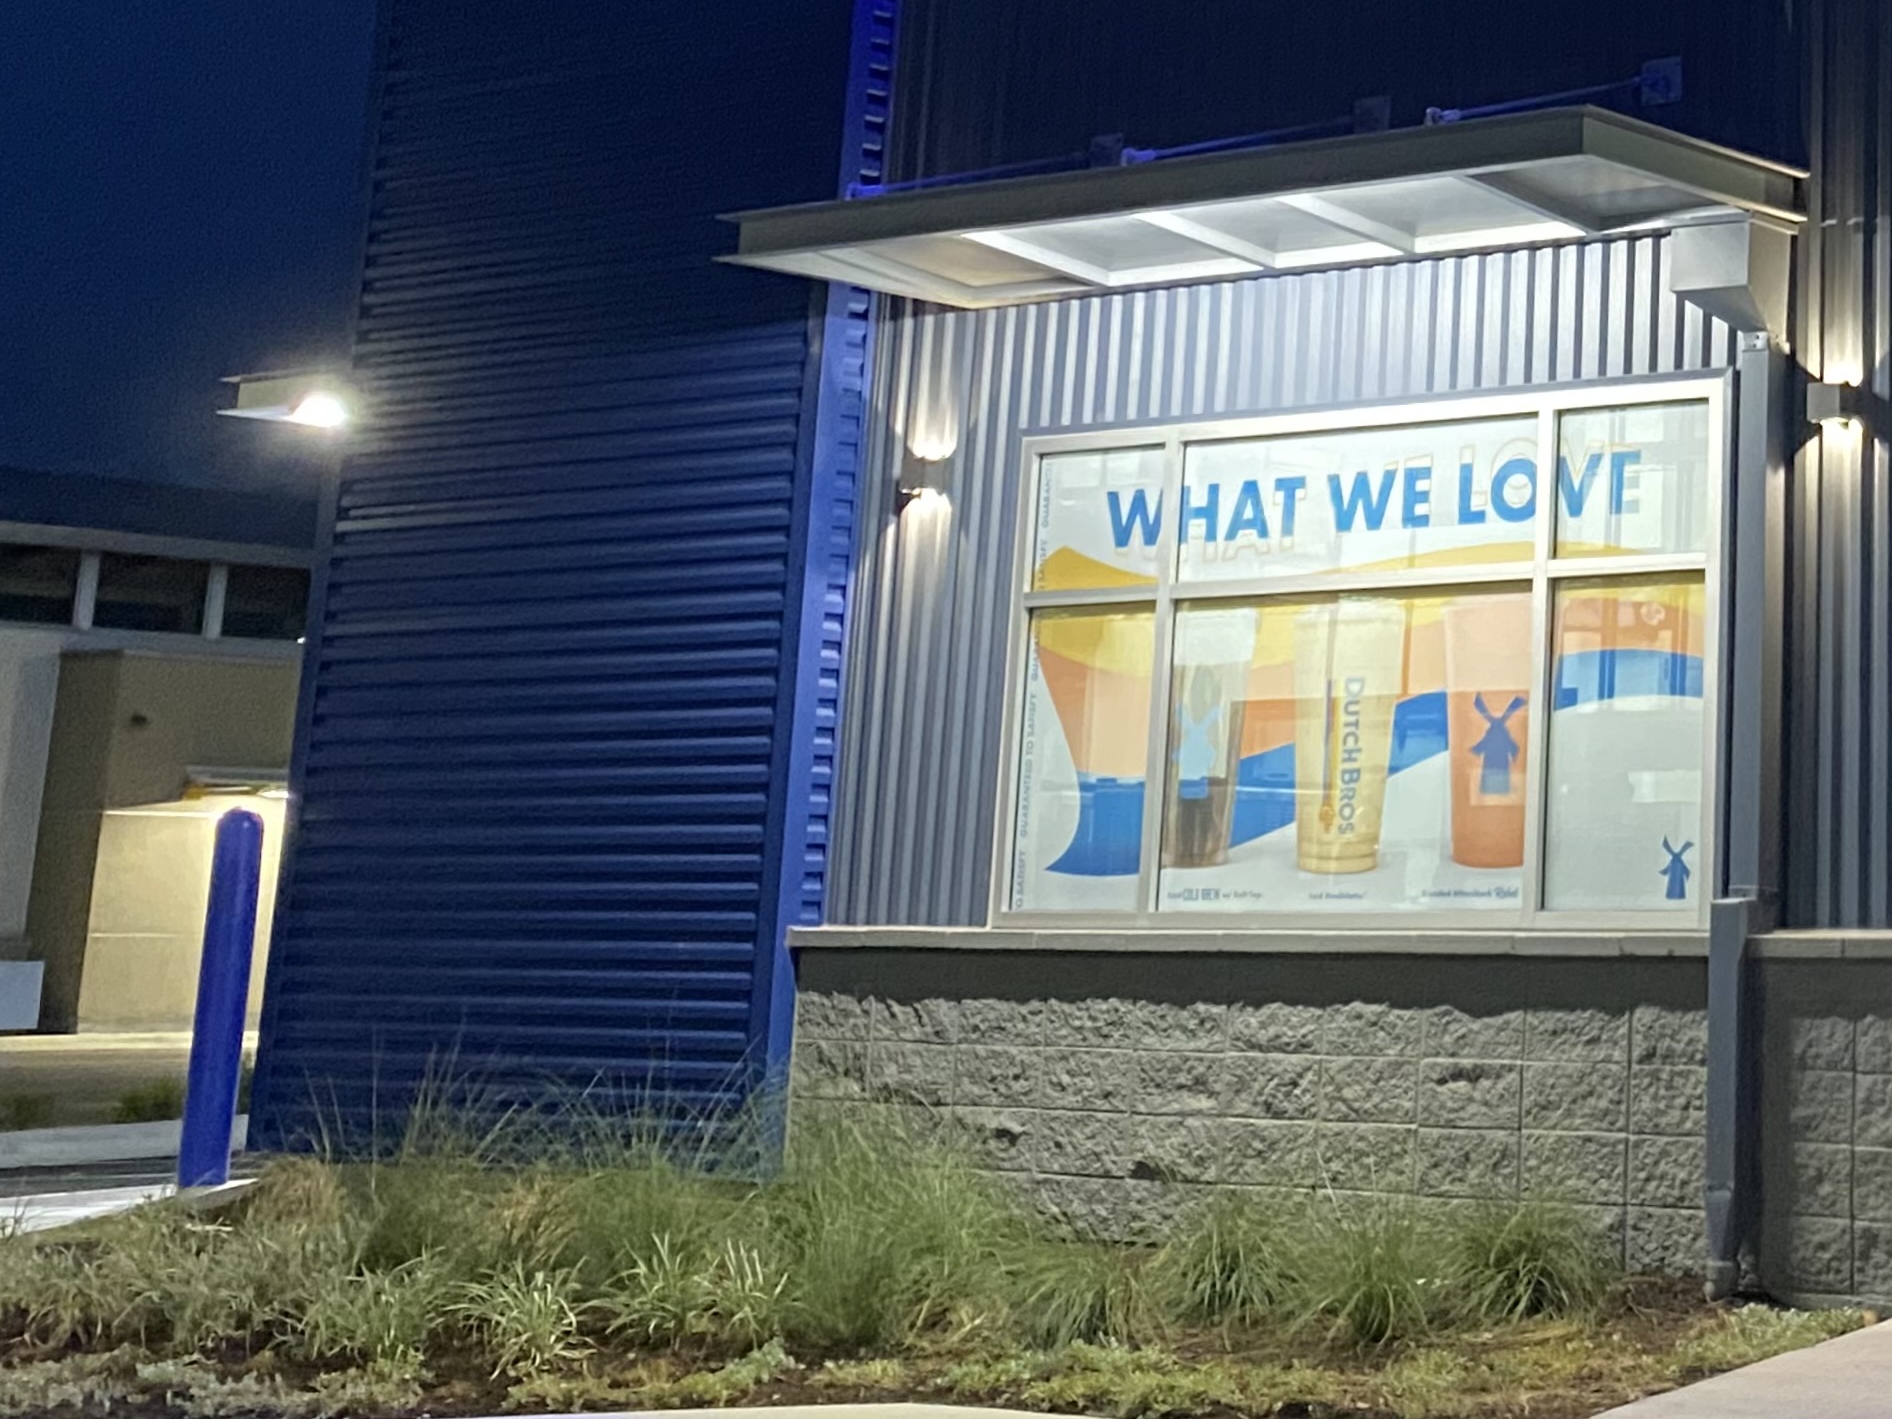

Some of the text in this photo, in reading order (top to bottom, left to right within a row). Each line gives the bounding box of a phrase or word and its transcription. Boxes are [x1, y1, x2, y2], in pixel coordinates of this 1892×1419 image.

[1107, 449, 1642, 550] WHAT WE LOVE
[1337, 768, 1361, 835] BROS
